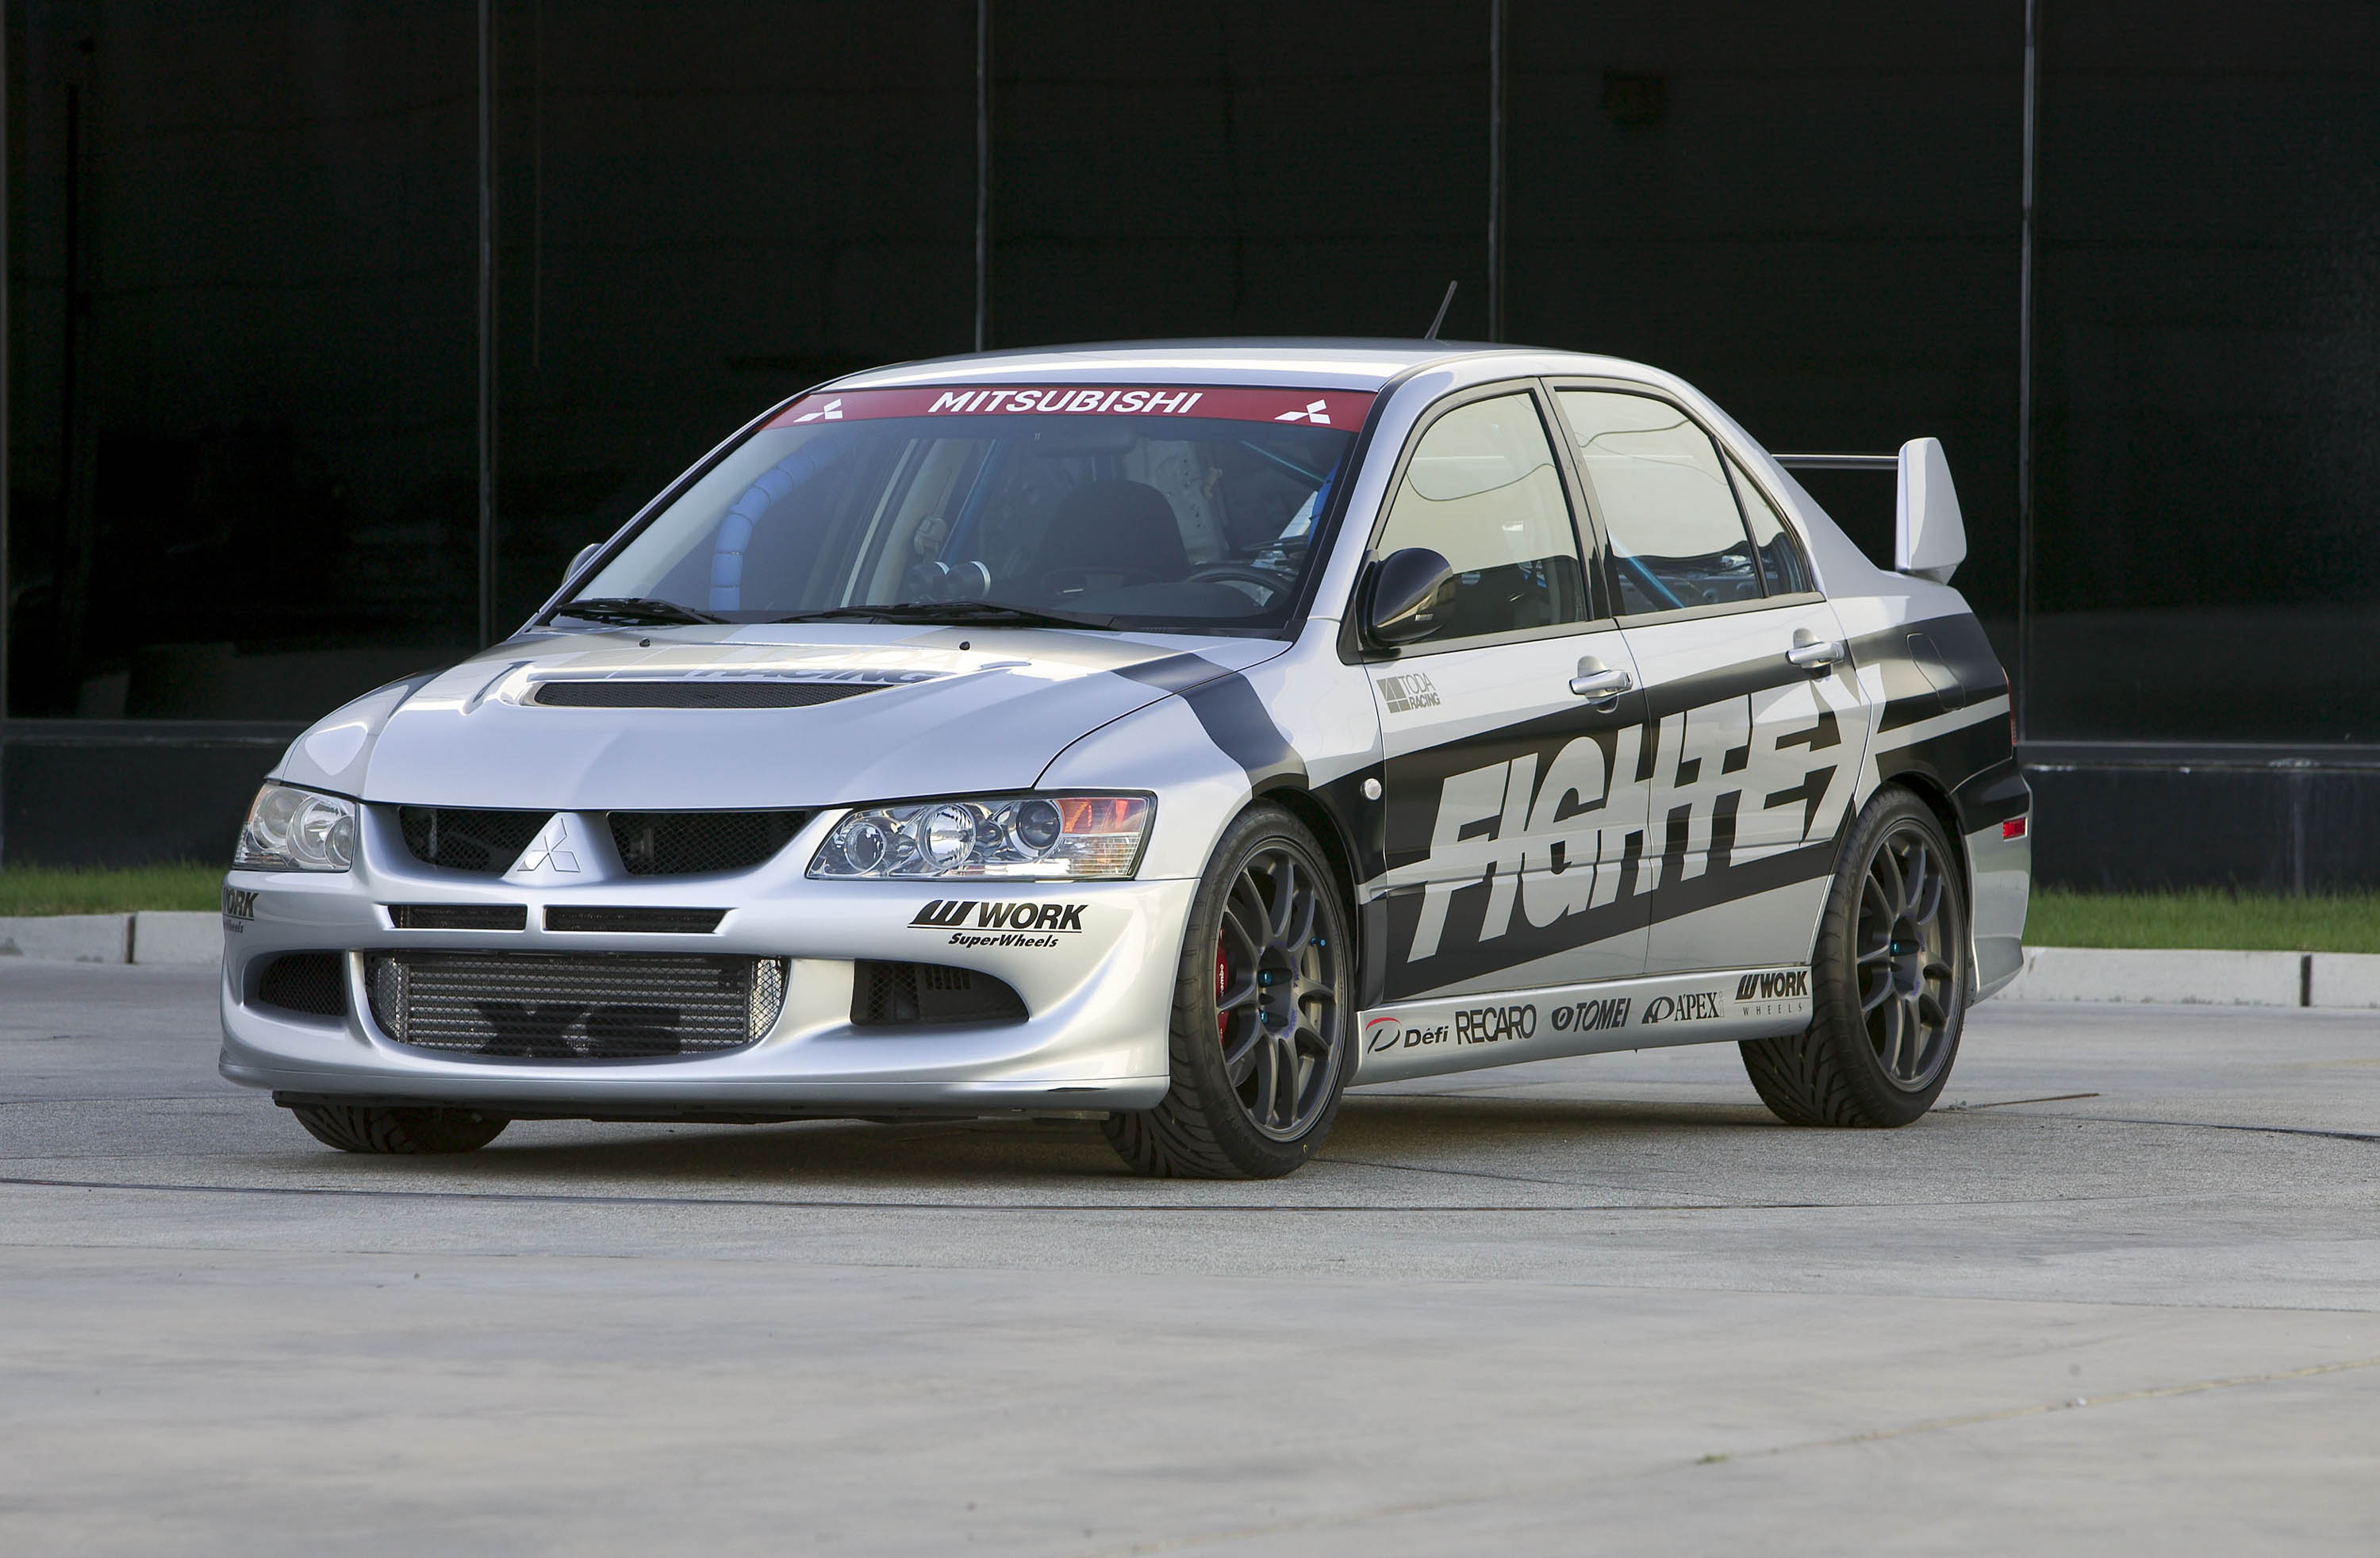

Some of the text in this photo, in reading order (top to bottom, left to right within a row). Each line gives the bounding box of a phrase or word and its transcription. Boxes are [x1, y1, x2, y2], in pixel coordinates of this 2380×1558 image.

[927, 390, 1203, 414] MITSUBISHI
[1397, 672, 1437, 695] TODA
[1408, 692, 1441, 710] RACING
[977, 901, 1089, 930] WORK
[948, 931, 1059, 949] SuperWheels
[1760, 970, 1808, 999] WORK
[1572, 997, 1632, 1033] TOMEI
[1742, 1002, 1803, 1016] WHEELS
[1454, 1003, 1537, 1046] RECARO
[1403, 1025, 1449, 1048] Défi
